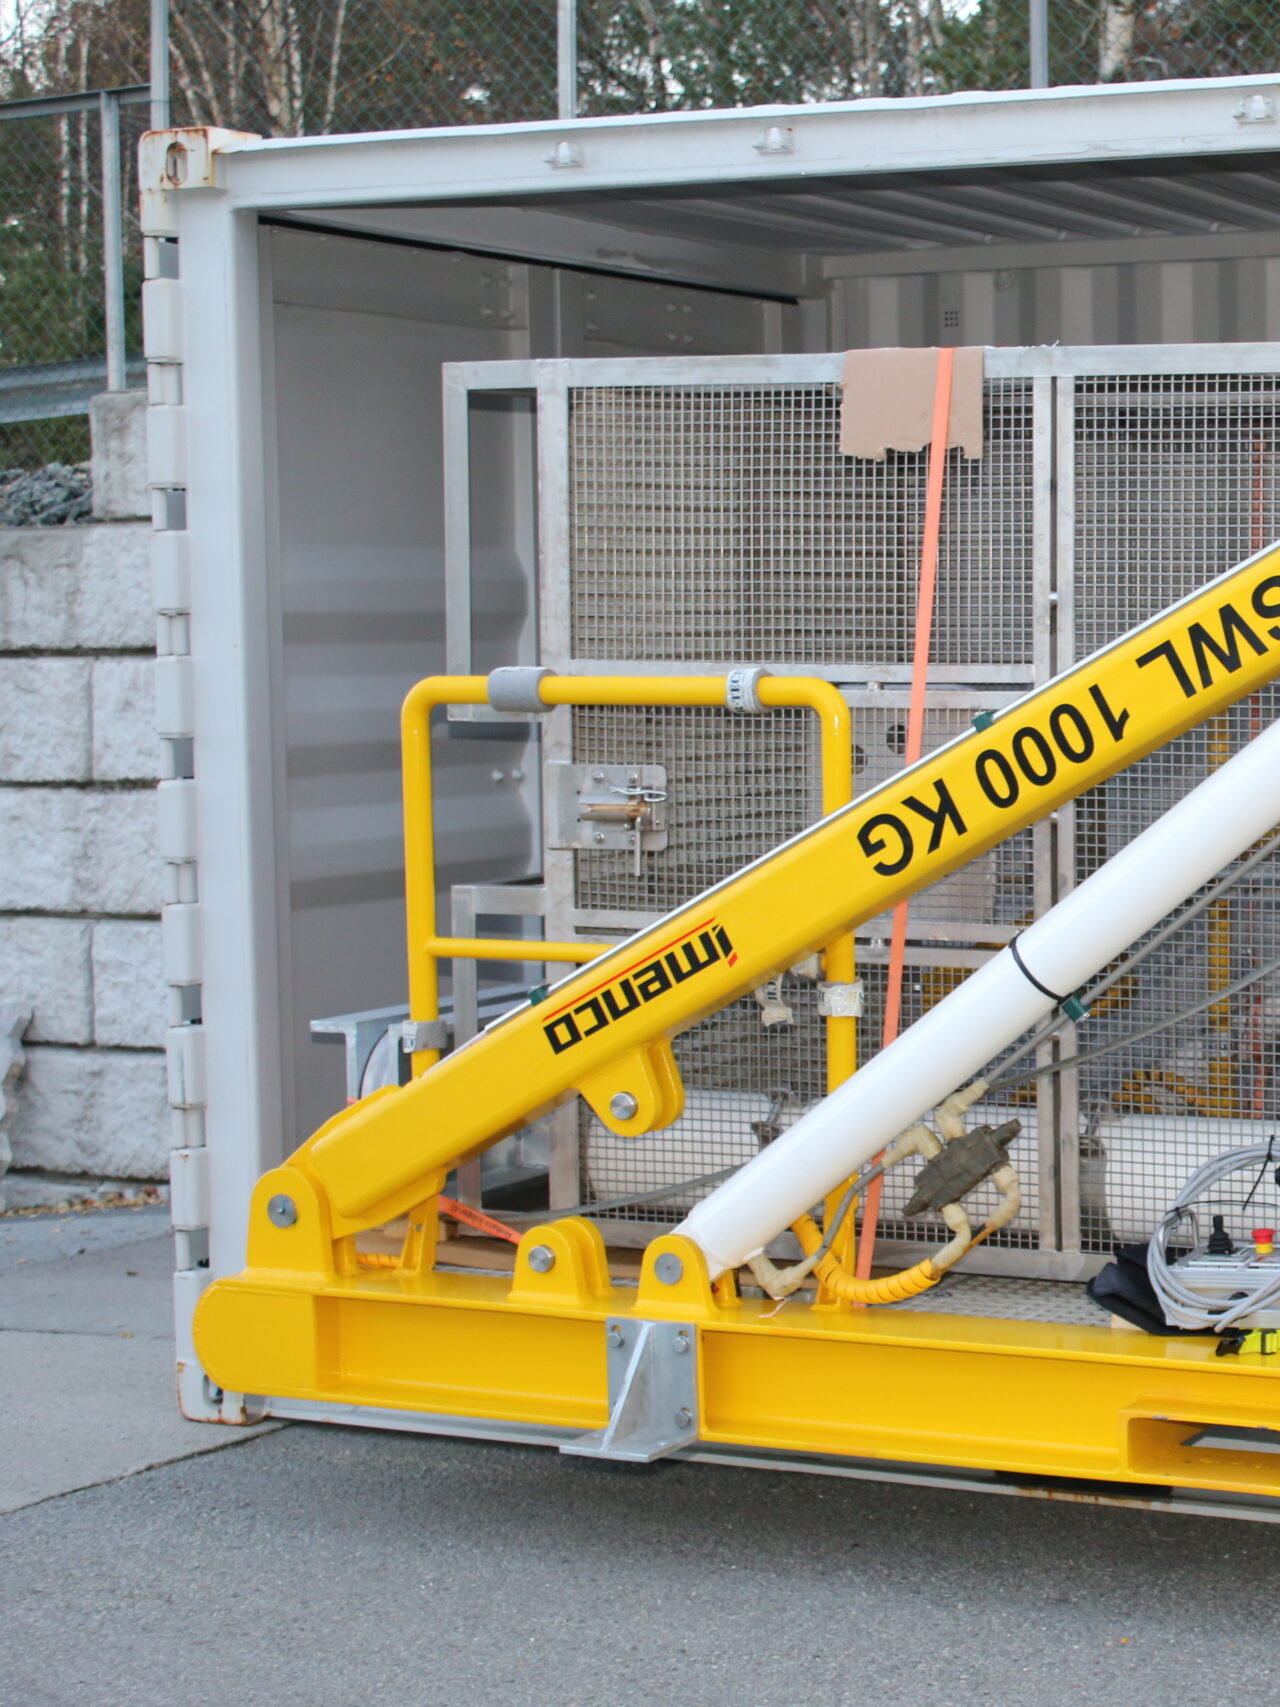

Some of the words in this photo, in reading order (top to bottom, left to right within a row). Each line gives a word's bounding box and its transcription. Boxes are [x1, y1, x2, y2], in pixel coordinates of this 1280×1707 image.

[975, 684, 1131, 809] 1000
[856, 778, 968, 877] KG
[543, 924, 738, 1055] imenco
